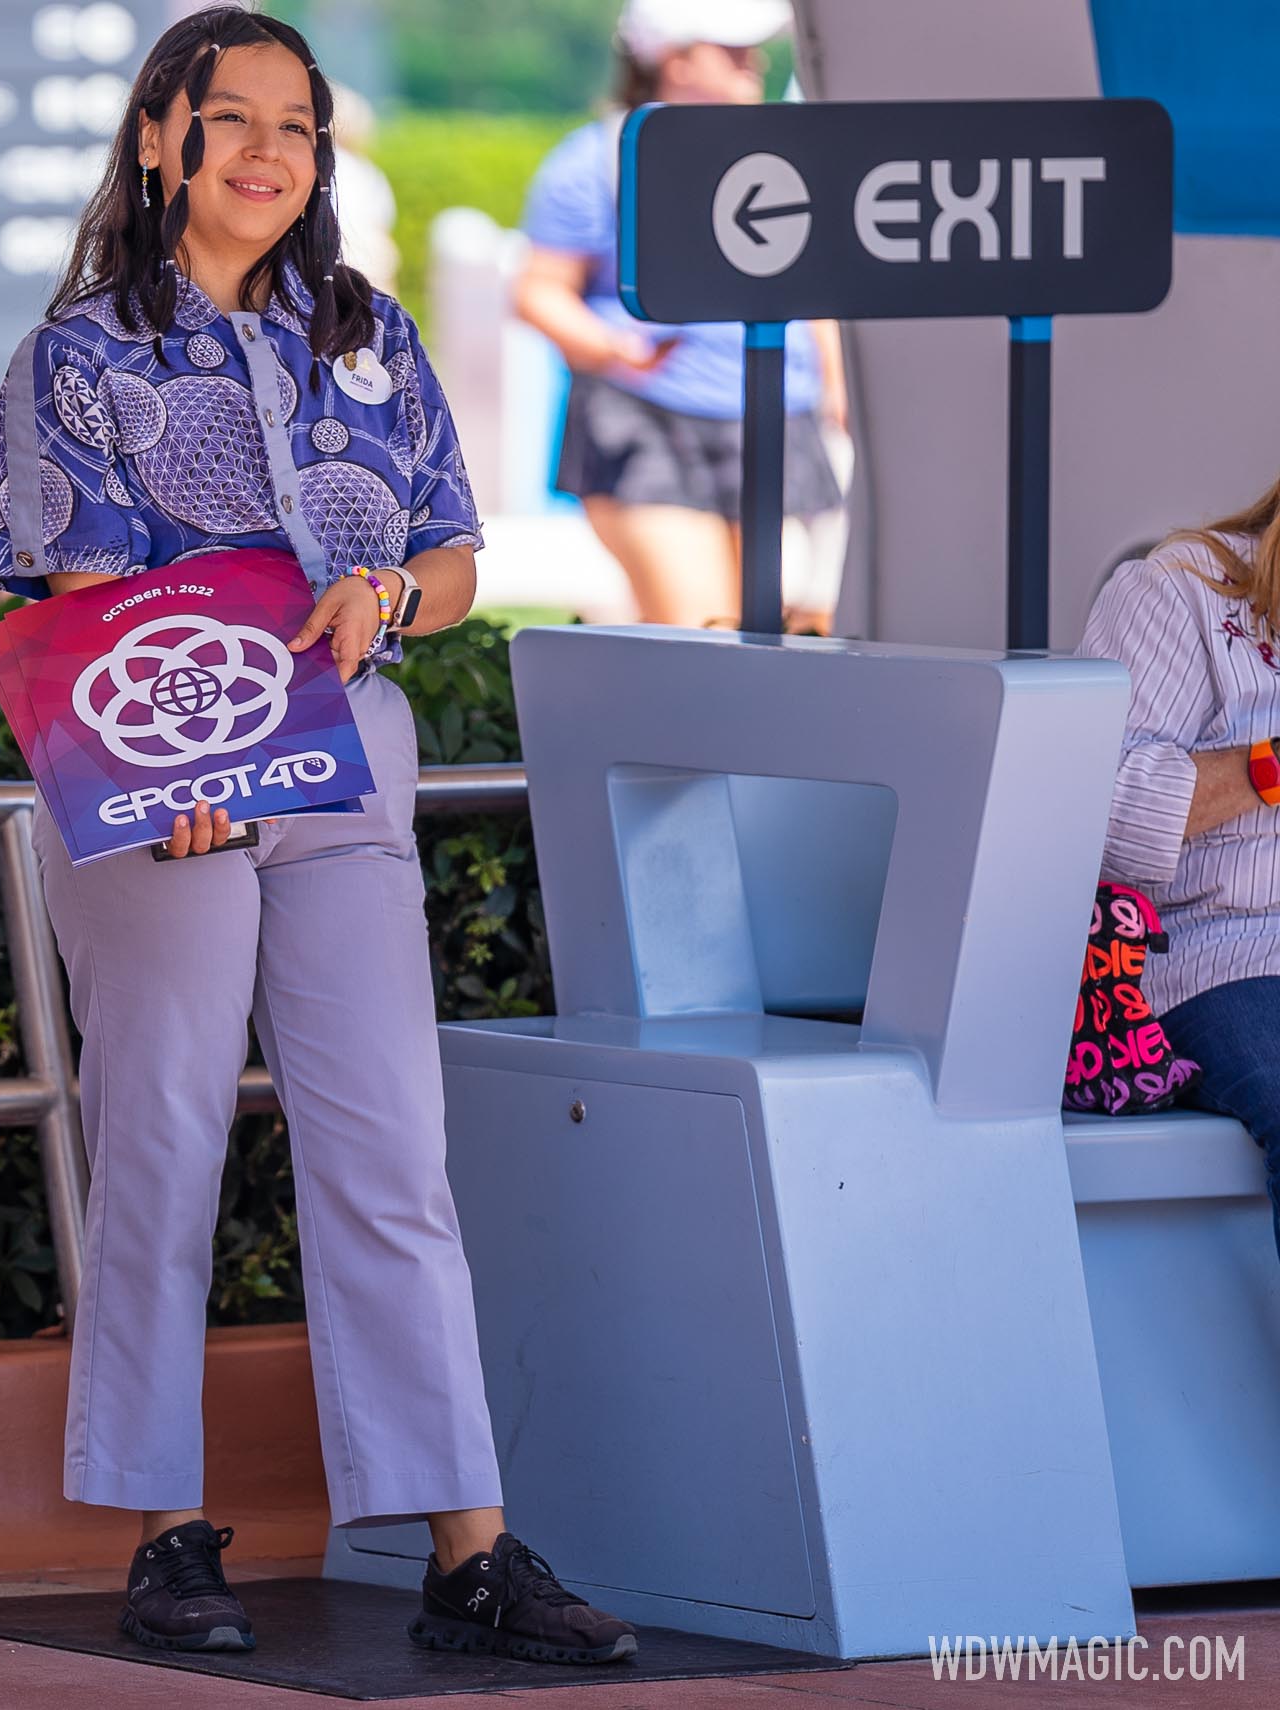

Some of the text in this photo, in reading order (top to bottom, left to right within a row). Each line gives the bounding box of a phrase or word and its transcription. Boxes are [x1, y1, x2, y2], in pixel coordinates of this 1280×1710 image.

[853, 156, 1107, 263] EXIT
[351, 373, 374, 388] FRIDA
[102, 584, 215, 622] OCTOBER 1, 2022
[98, 750, 338, 826] EPCOT 40
